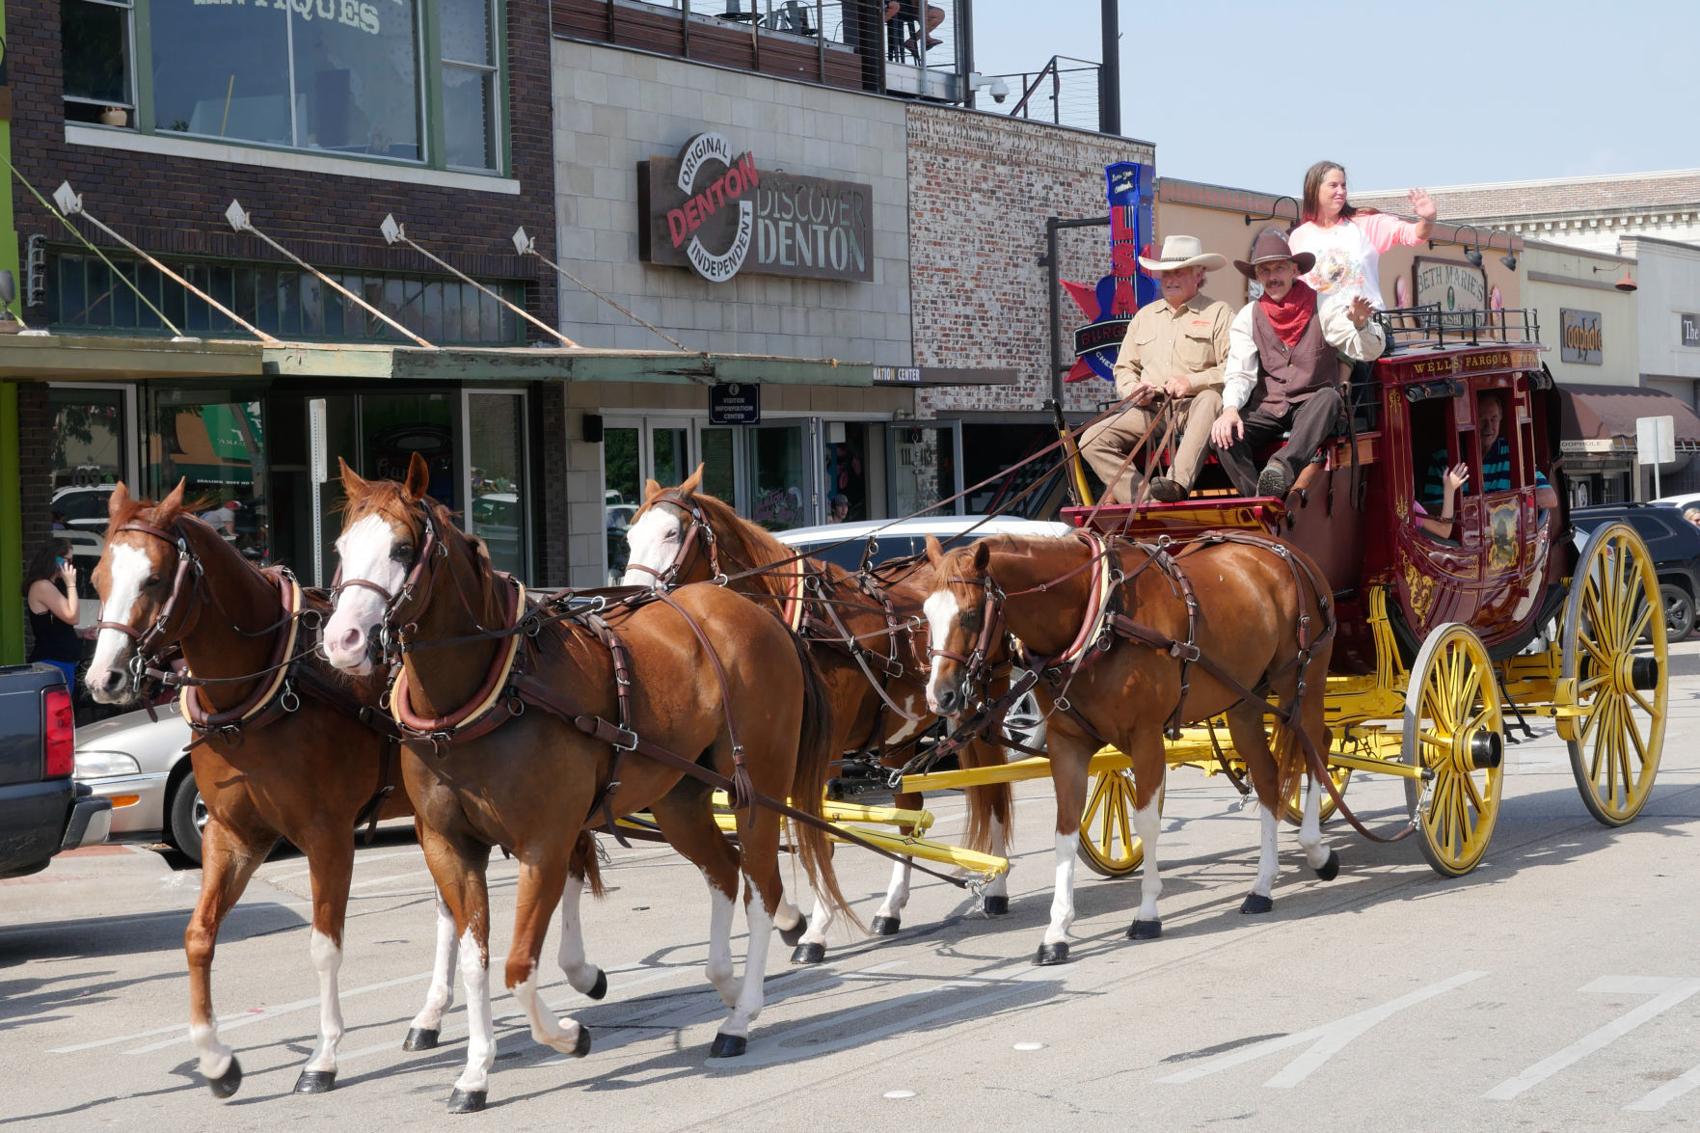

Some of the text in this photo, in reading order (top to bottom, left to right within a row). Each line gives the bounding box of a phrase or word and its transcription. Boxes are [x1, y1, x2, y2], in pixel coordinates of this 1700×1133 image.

[682, 137, 728, 186] ORIGINAL
[667, 151, 760, 249] DENTON
[757, 183, 867, 227] DISCOVER
[691, 207, 751, 278] INDEPENDENT
[758, 218, 866, 273] DENTON
[1418, 265, 1484, 302] BETH MARIE'S
[1683, 320, 1700, 340] The
[898, 368, 920, 381] CENTER
[1414, 356, 1460, 374] WELLS
[1465, 355, 1498, 367] FARGO
